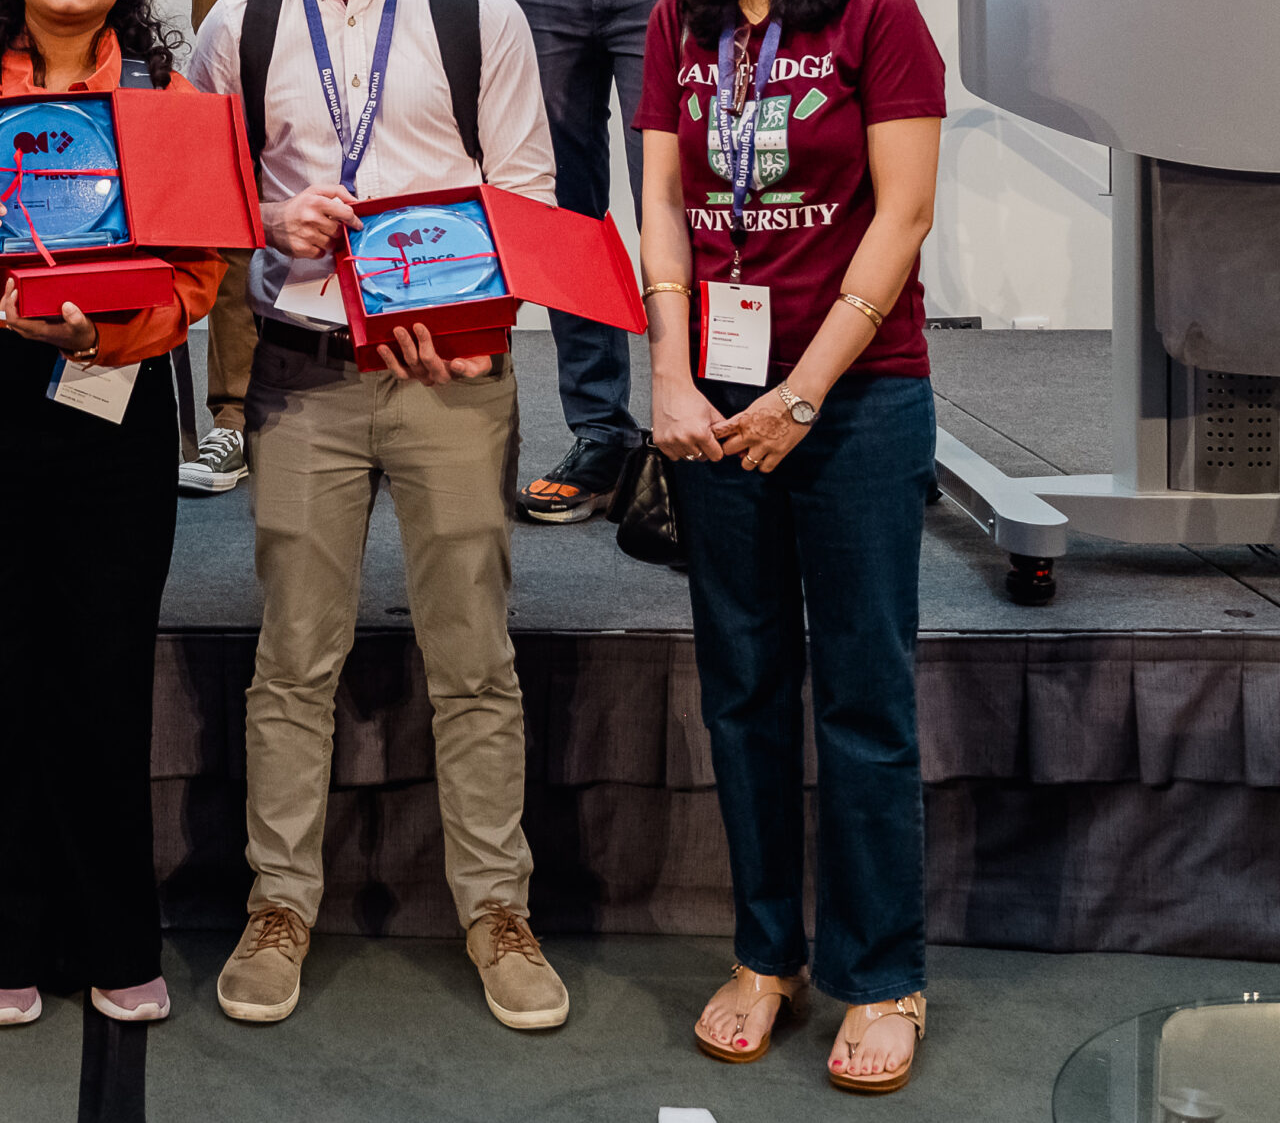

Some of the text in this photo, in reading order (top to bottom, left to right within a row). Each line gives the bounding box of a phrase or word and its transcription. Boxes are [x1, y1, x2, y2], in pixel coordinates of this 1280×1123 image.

[348, 71, 380, 161] NYUAD Engineering
[736, 121, 754, 188] Engineering
